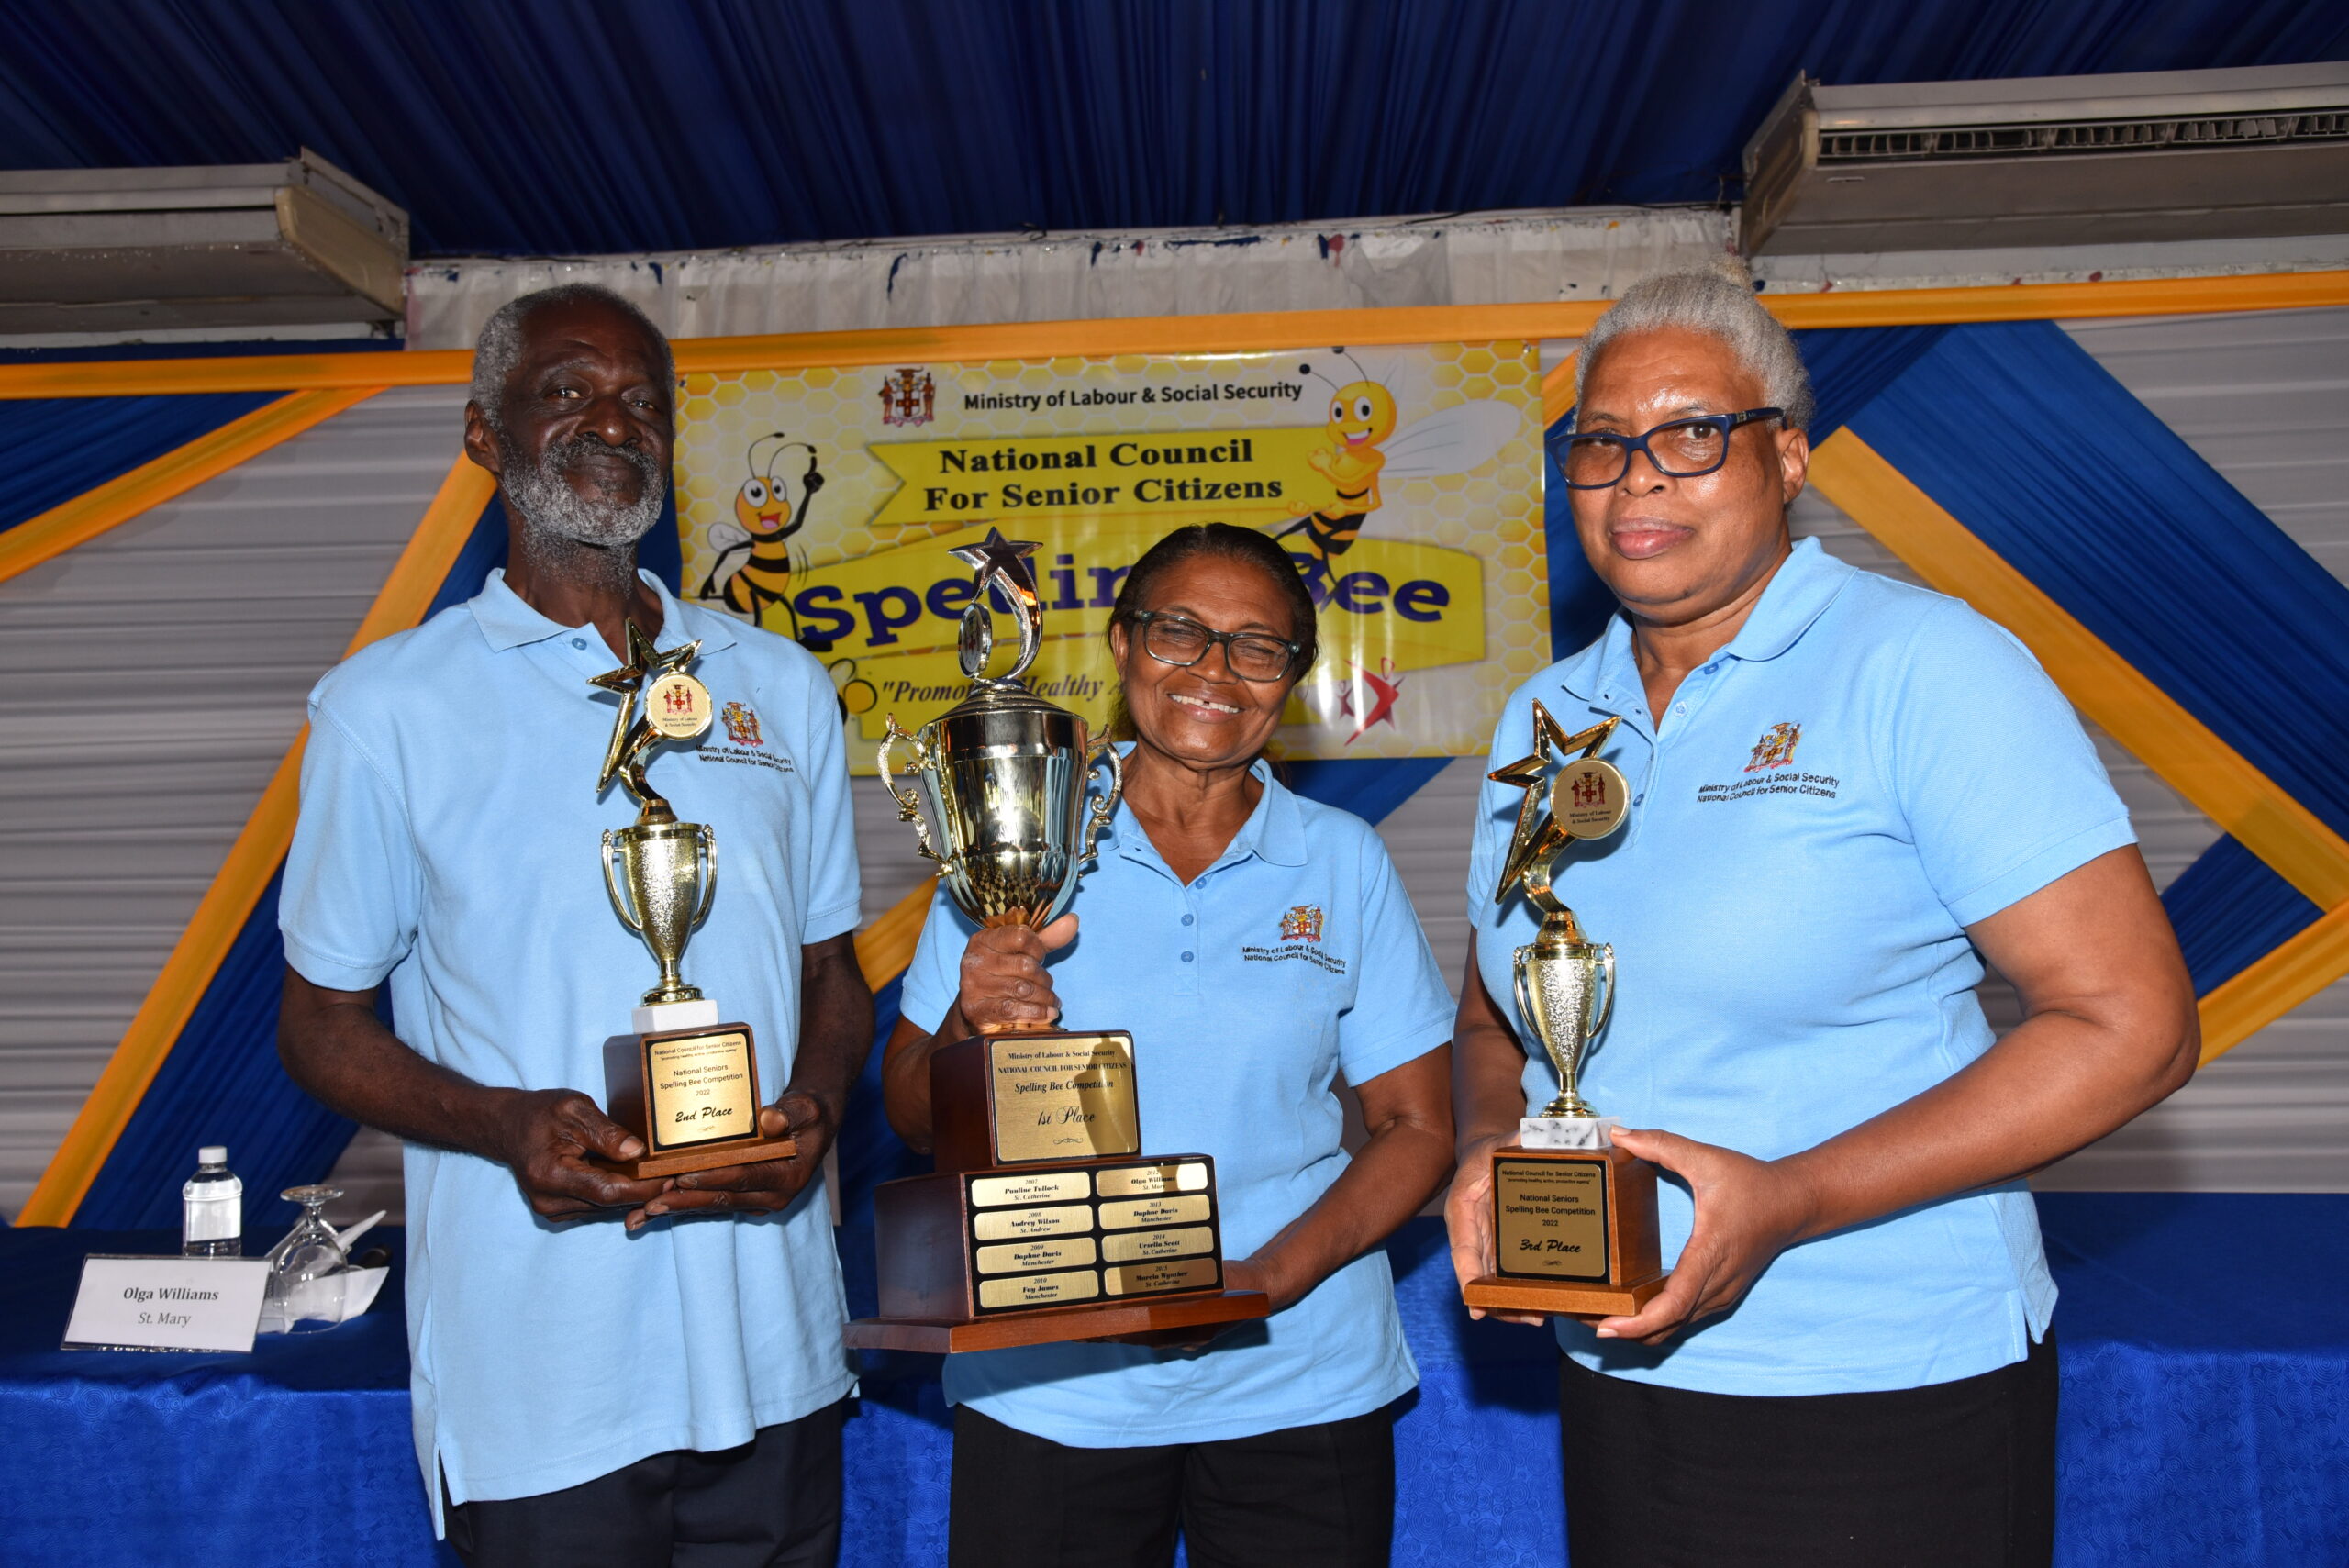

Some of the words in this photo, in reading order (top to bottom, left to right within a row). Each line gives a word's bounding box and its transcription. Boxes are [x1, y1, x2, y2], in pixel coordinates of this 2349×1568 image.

[964, 393, 1041, 412] Ministry
[1046, 390, 1066, 406] of
[1071, 389, 1137, 406] Labour
[1141, 387, 1157, 403] &
[1161, 384, 1219, 402] Social
[1224, 382, 1303, 401] Security
[939, 445, 1097, 473] National
[1109, 439, 1253, 467] Council
[924, 487, 989, 511] For
[1002, 482, 1120, 508] Senior
[1133, 477, 1283, 503] Citizens
[1698, 783, 1733, 794] Ministry
[1731, 782, 1739, 790] of
[1739, 777, 1765, 789] Labour
[1774, 772, 1799, 783] Social
[1802, 772, 1840, 789] Security
[1697, 793, 1730, 803] National
[1729, 789, 1755, 801] Council
[1756, 786, 1768, 795] for
[1769, 784, 1798, 794] Senior
[1799, 784, 1836, 799] Citizens
[1242, 946, 1269, 955] Ministry
[1274, 952, 1299, 961] Council
[1008, 1052, 1033, 1061] Ministry
[1091, 1049, 1116, 1057] Security
[674, 1067, 702, 1077] National
[703, 1064, 729, 1073] Seniors
[660, 1079, 687, 1090] Spelling
[703, 1073, 743, 1084] Competition
[1014, 1083, 1048, 1095] Spelling
[1050, 1082, 1063, 1090] Bee
[674, 1110, 697, 1123] 2nd
[701, 1106, 733, 1119] Place
[1037, 1111, 1052, 1126] 1st
[1056, 1106, 1097, 1125] Place
[1520, 1194, 1550, 1202] National
[1552, 1195, 1579, 1203] Seniors
[1505, 1206, 1533, 1216] Spelling
[1551, 1207, 1596, 1216] Competition
[1520, 1239, 1542, 1251] 3rd
[1546, 1239, 1581, 1253] Place
[1014, 1252, 1040, 1261] Daphne
[123, 1287, 154, 1303] Olga
[159, 1287, 219, 1300] Williams
[138, 1311, 153, 1324] St.
[157, 1312, 191, 1328] Mary
